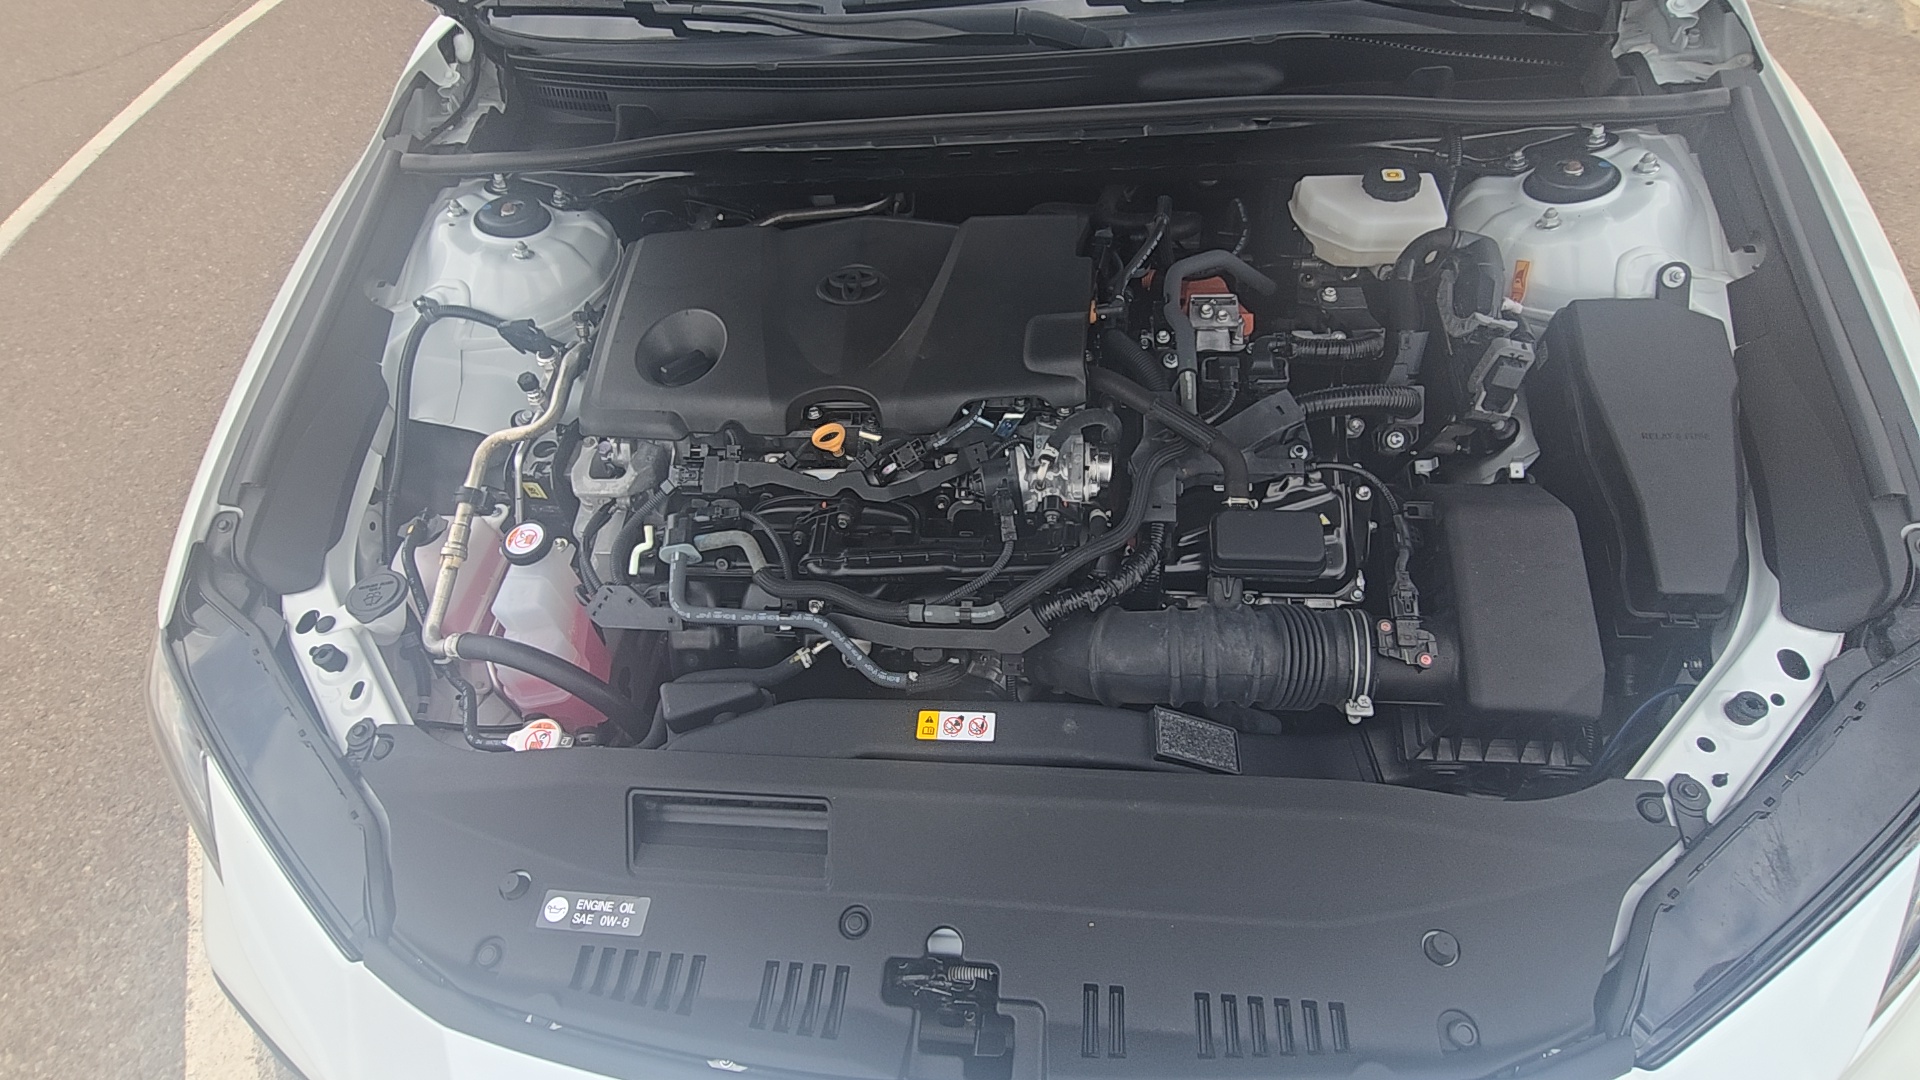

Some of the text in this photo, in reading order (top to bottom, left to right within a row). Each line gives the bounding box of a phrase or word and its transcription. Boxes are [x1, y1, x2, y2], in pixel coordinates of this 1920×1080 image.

[576, 899, 636, 914] ENGINE OIL
[572, 913, 630, 928] SAE 0W-8
